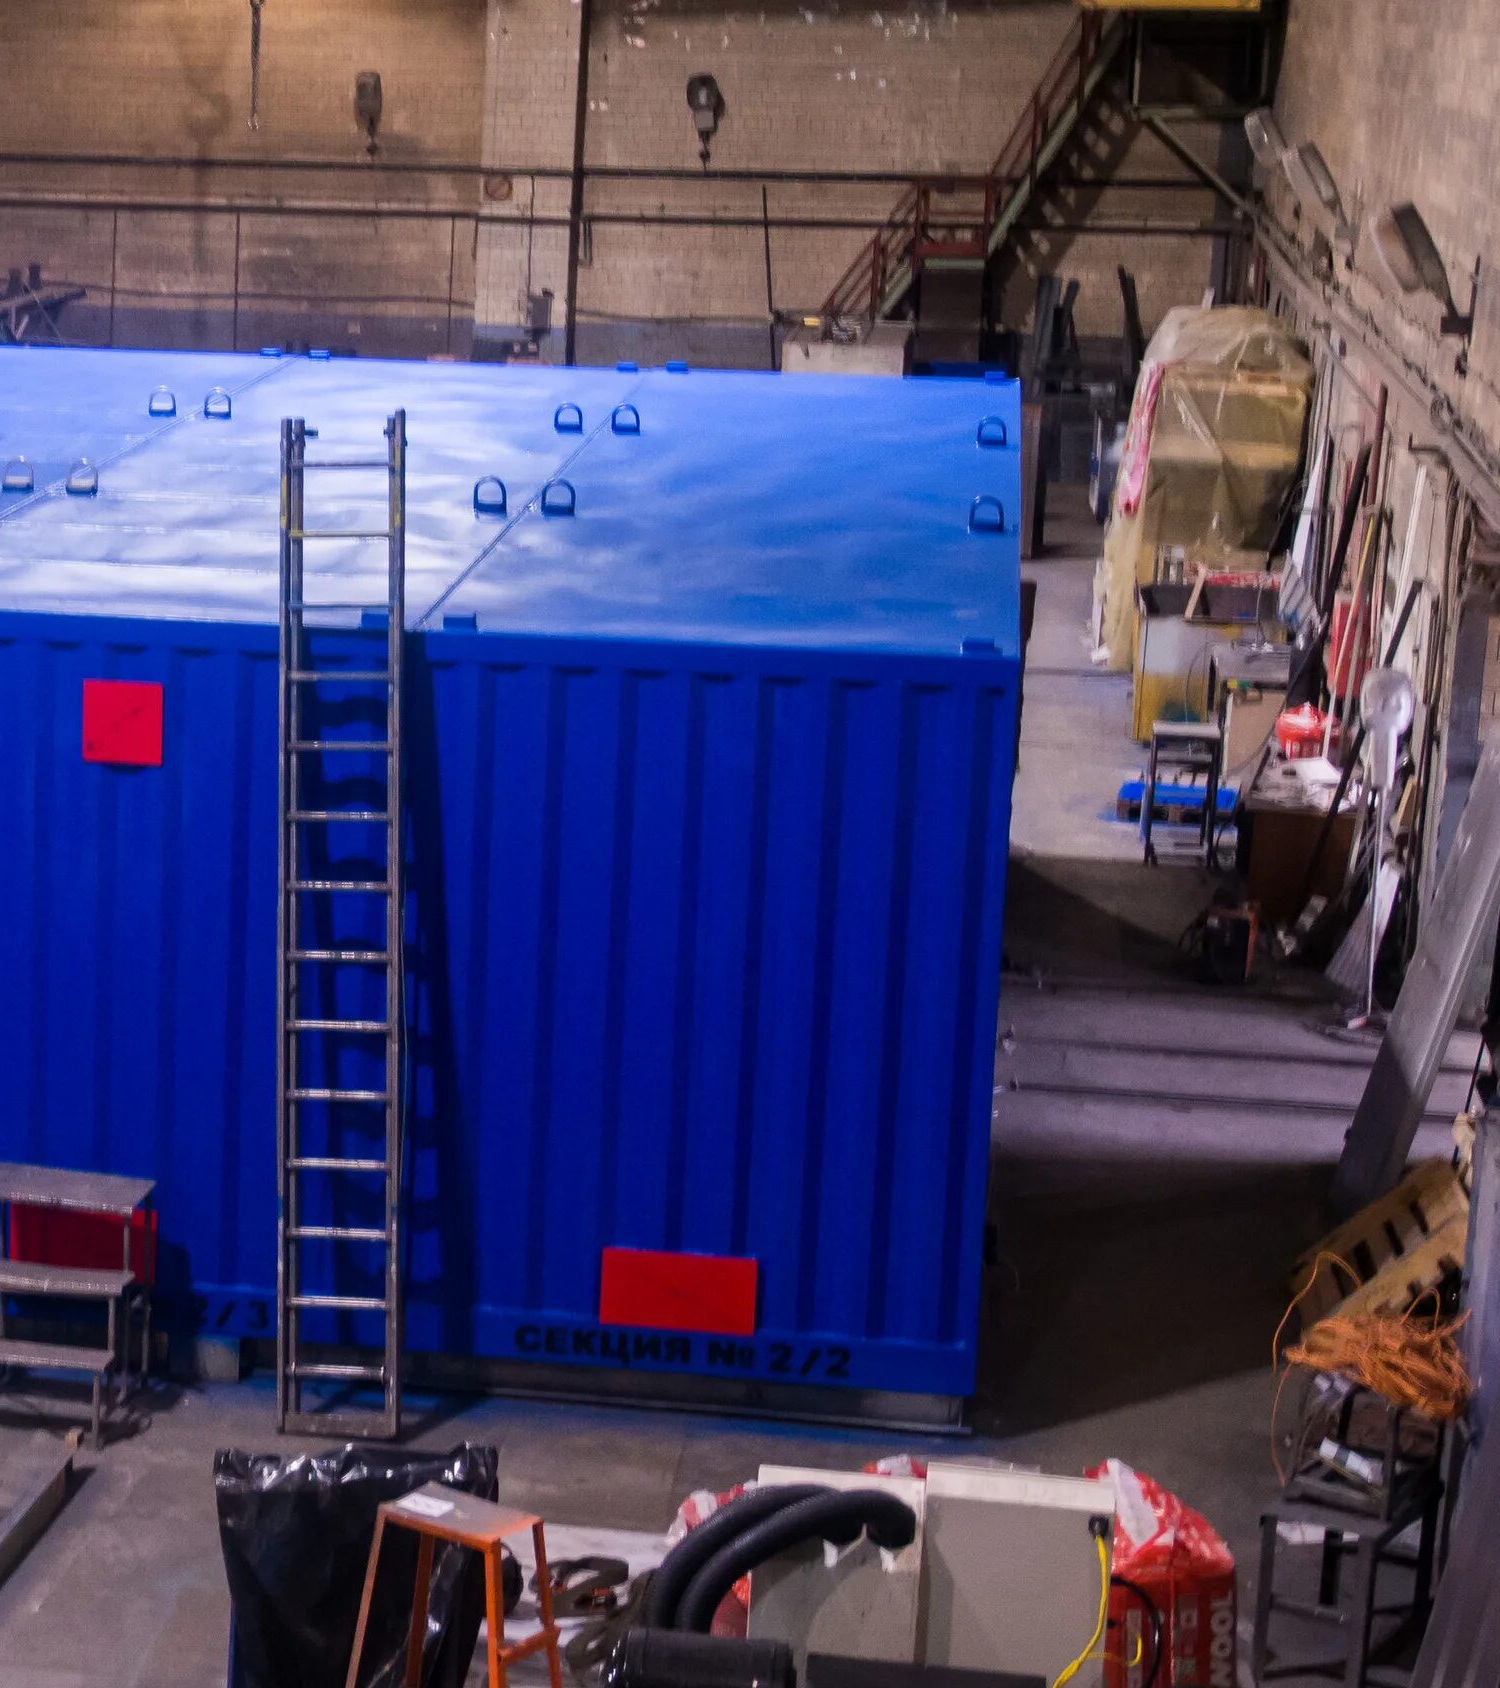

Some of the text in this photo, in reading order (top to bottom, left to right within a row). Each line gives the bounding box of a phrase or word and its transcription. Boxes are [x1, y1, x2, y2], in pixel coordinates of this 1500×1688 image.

[514, 1324, 851, 1378] СЕКЦИЯ № 2/2
